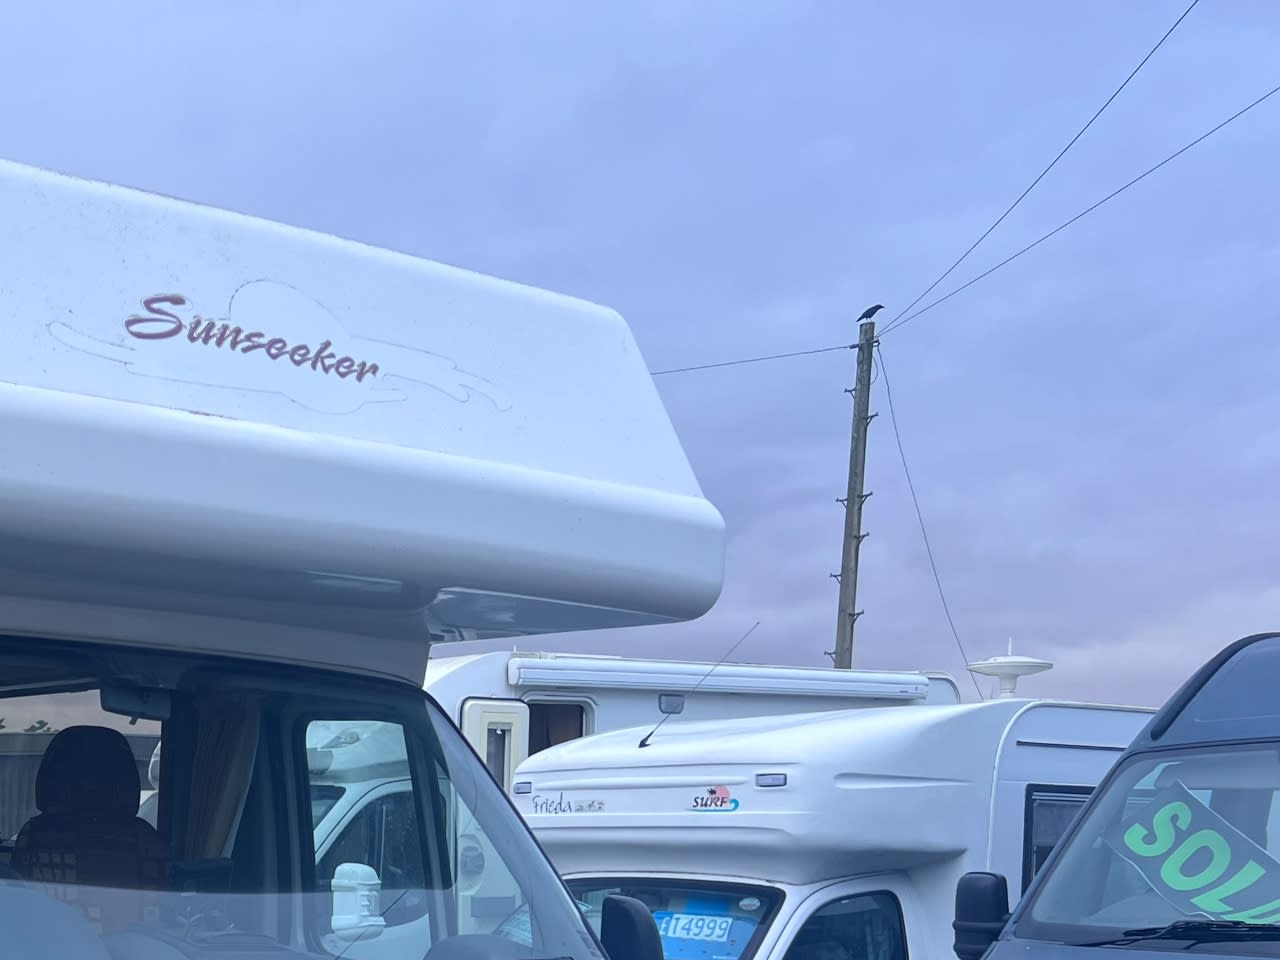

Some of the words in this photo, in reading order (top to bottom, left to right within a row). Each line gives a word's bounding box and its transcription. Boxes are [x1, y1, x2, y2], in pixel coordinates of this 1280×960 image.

[124, 294, 380, 382] Sunseeker
[532, 792, 572, 814] Frieda
[692, 796, 728, 808] SURF
[660, 916, 730, 938] £14999
